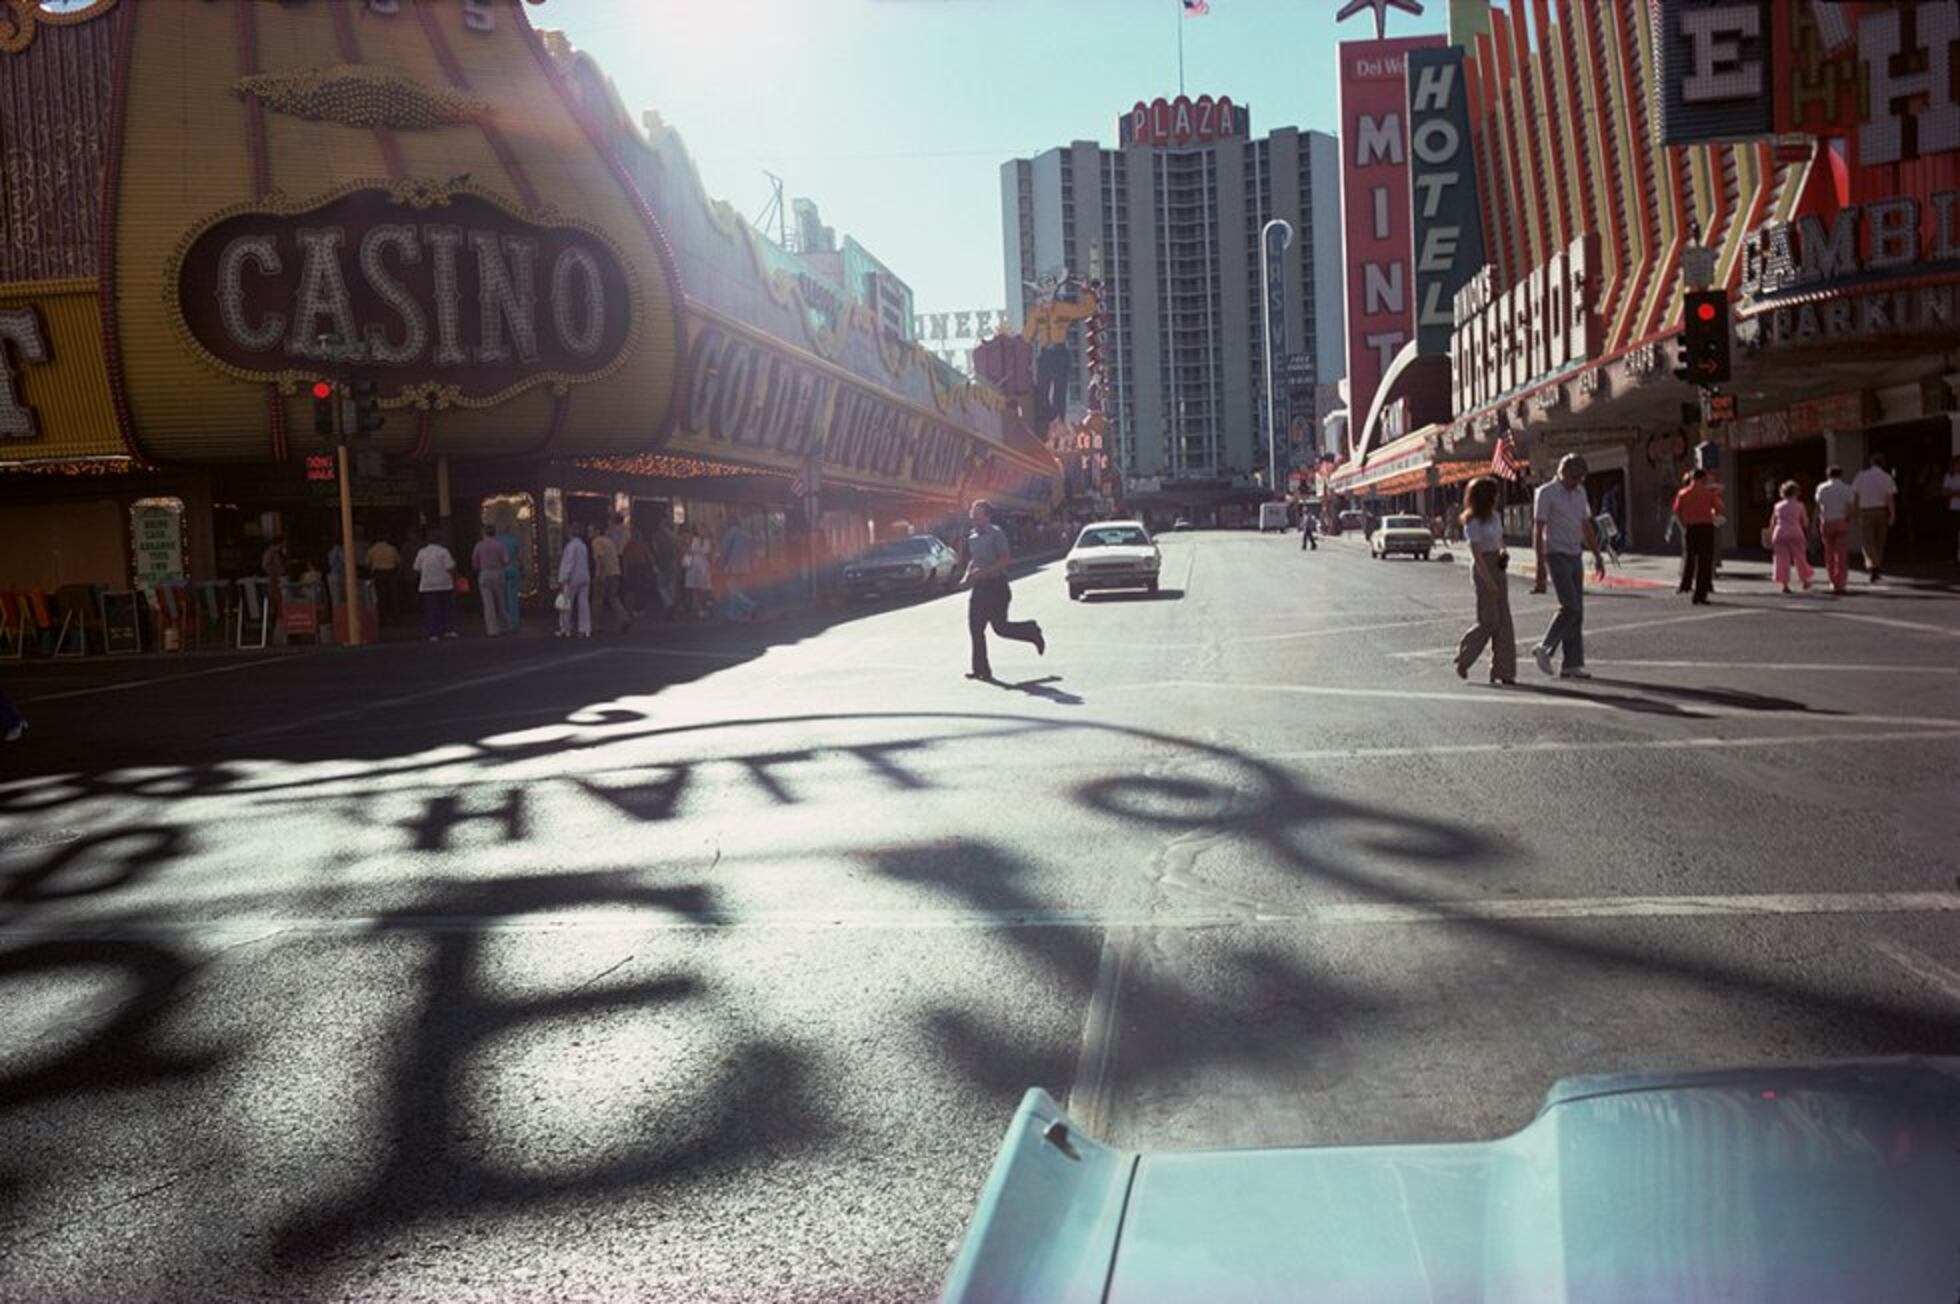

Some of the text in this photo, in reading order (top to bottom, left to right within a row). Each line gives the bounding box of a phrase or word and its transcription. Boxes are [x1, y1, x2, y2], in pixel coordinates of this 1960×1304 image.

[1134, 102, 1233, 141] PLAZA
[1412, 64, 1456, 327] HOTEL
[216, 223, 605, 365] CASINO
[1356, 113, 1405, 380] MINT
[1450, 234, 1586, 420] HORSESHOE
[690, 321, 834, 456] GOLDEN
